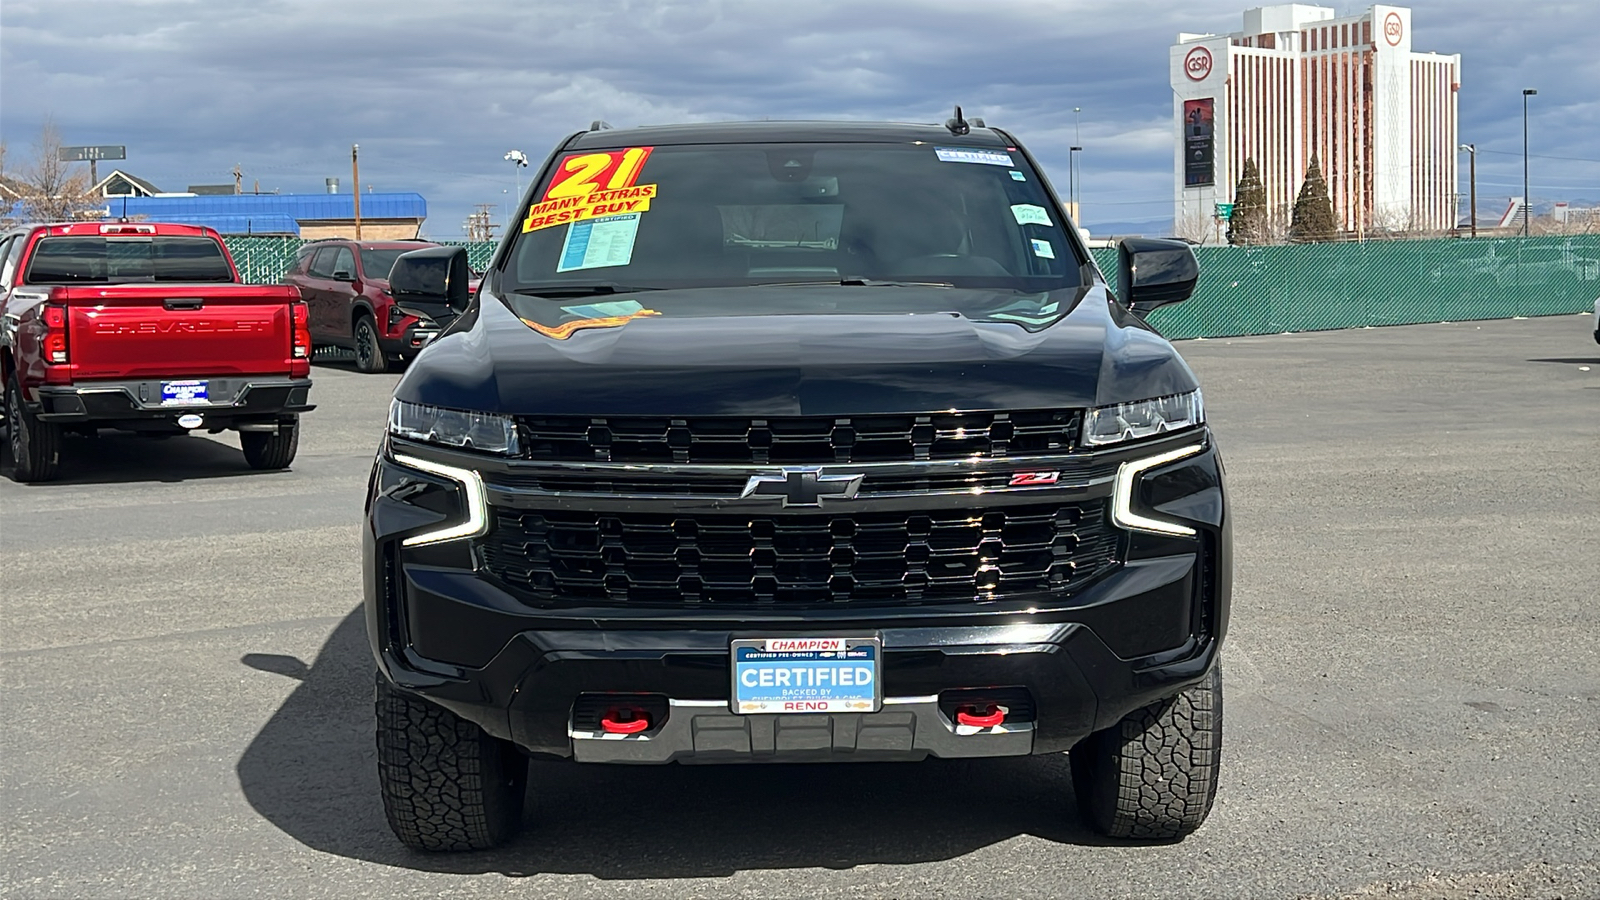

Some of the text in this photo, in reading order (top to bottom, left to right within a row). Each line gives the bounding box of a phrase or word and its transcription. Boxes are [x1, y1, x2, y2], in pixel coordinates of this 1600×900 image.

[1387, 22, 1400, 36] GSR
[1188, 56, 1208, 71] GSR
[547, 147, 647, 199] 21
[531, 186, 653, 217] MANY EXTRAS
[529, 199, 643, 229] BEST BUY
[594, 215, 635, 223] CERTIFIED
[96, 321, 269, 334] CHEVROLET
[772, 640, 839, 650] CHAMPION
[741, 667, 873, 688] CERTIFIED
[784, 702, 828, 711] RENO
